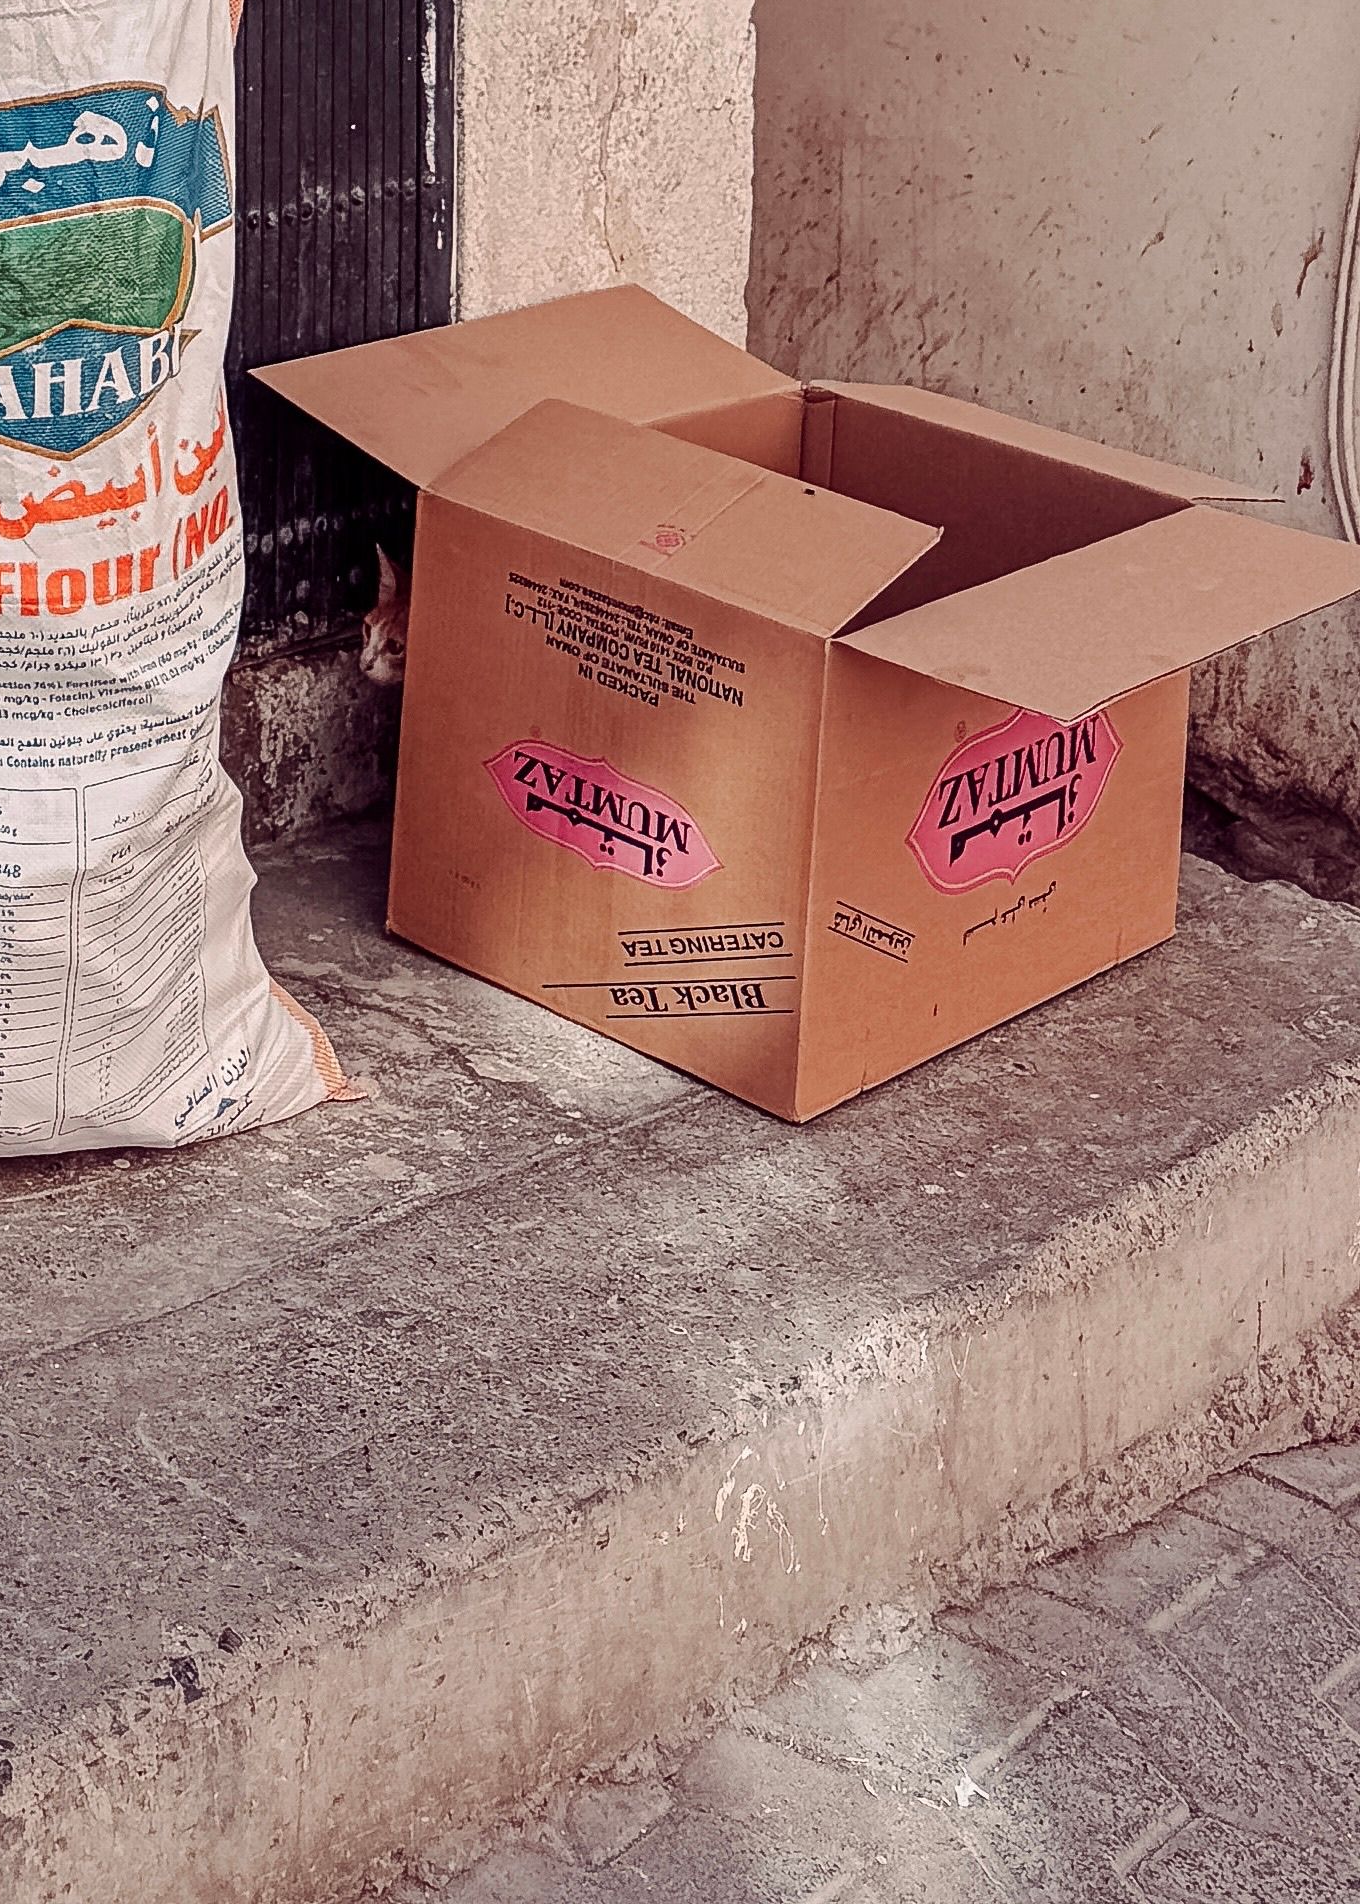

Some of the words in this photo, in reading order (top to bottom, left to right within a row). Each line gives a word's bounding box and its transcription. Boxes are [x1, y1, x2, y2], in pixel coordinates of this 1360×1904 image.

[556, 618, 631, 661] COMPANY
[585, 615, 620, 639] POSTAL
[544, 632, 581, 658] OMAN
[582, 650, 600, 666] OF
[577, 661, 594, 681] IN
[601, 656, 670, 695] SULTANATE
[632, 647, 663, 676] TEA
[596, 669, 660, 708] PACKED
[666, 660, 745, 708] NATIONAL
[671, 686, 697, 705] THE
[3, 694, 40, 706] mg/kg
[6, 755, 56, 769] Contains
[58, 748, 108, 768] naturally
[110, 737, 153, 760] present
[936, 715, 1101, 831] MUMTAZ
[512, 749, 693, 856] MUMTAZ
[525, 790, 673, 878] ممتاز
[948, 772, 1083, 869] ممتاز
[621, 937, 665, 959] TEA
[670, 929, 786, 956] CATERING
[608, 986, 670, 1013] Tea
[675, 982, 769, 1012] Black
